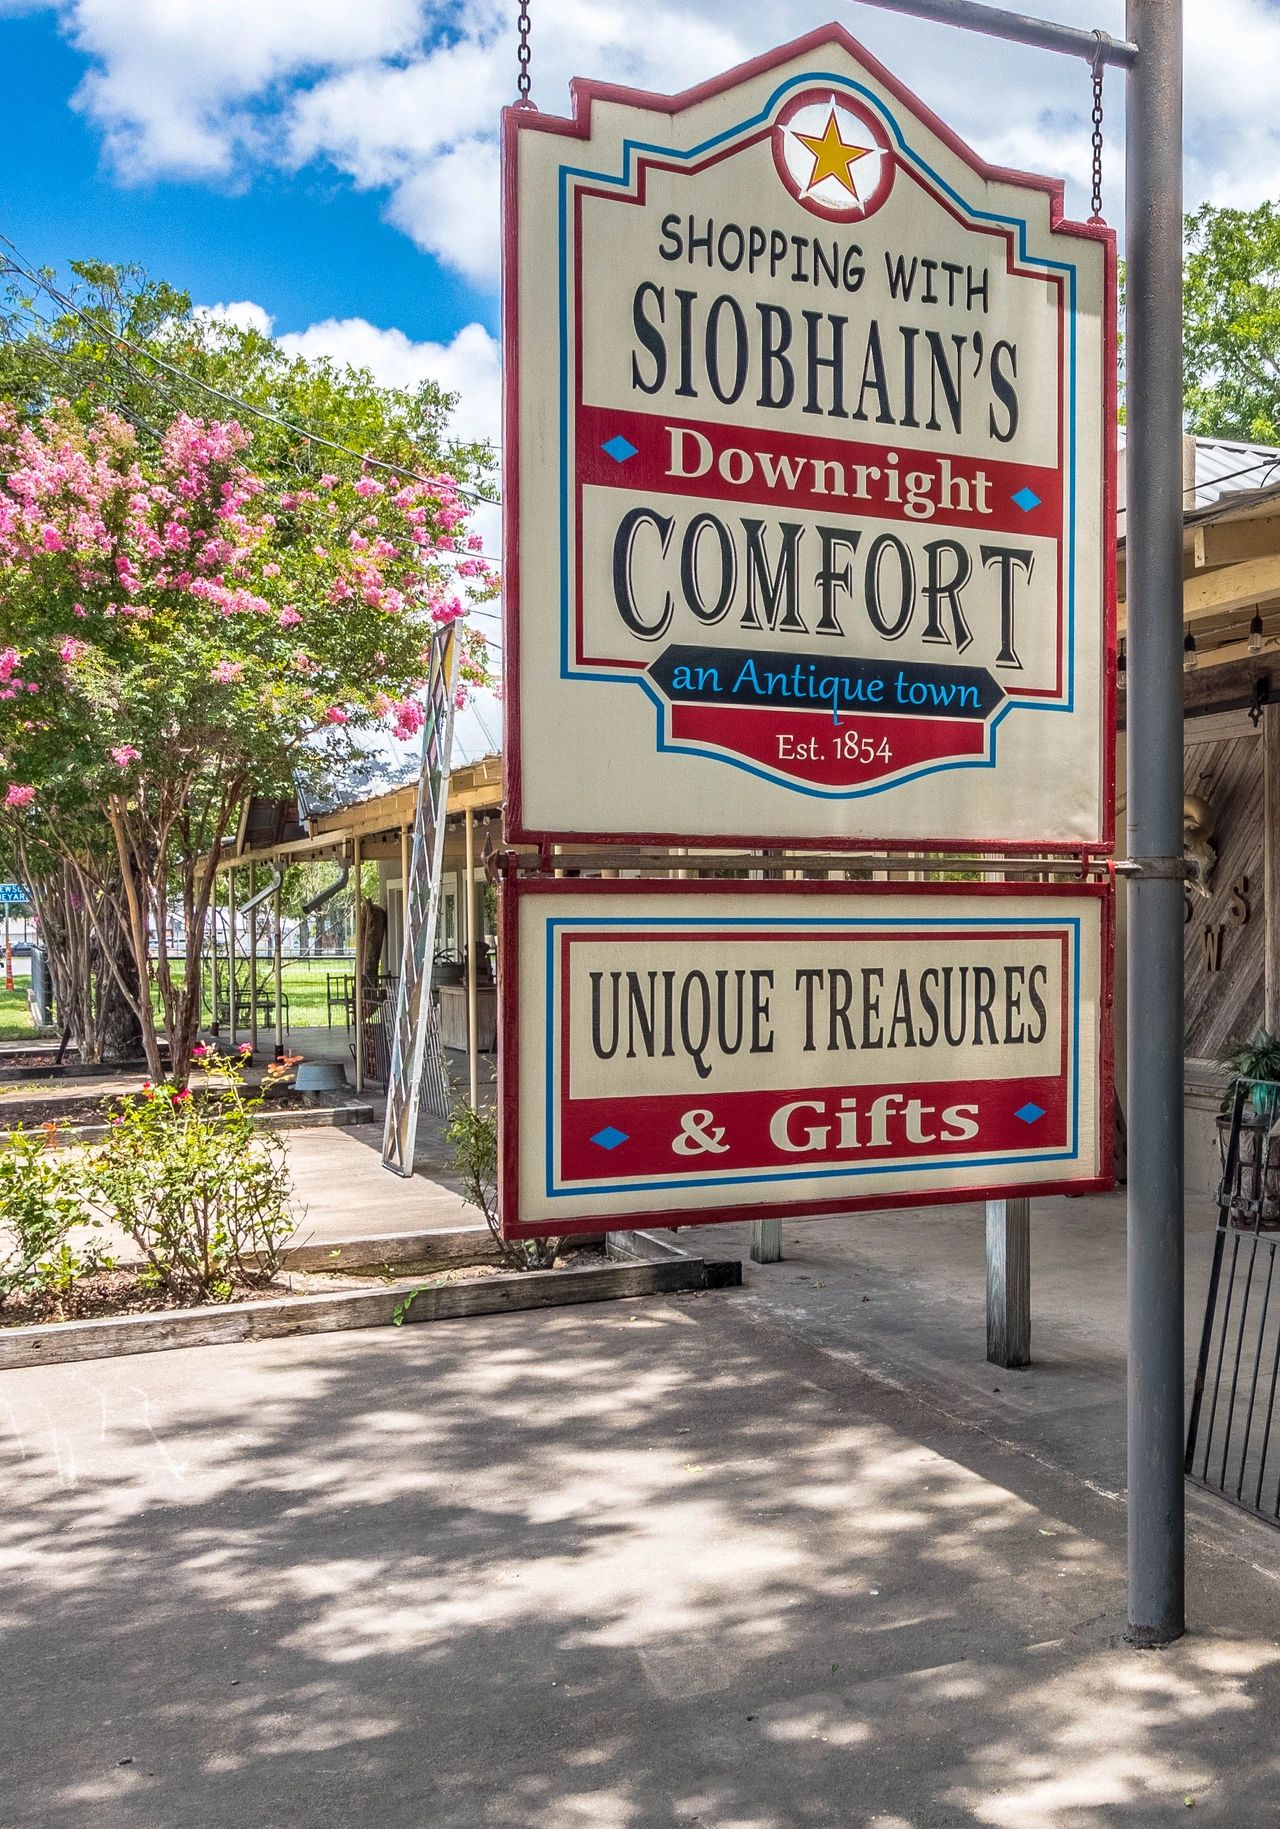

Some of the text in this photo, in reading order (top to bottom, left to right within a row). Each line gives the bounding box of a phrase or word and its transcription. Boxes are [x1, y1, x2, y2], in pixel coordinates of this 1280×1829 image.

[658, 213, 989, 314] SHOPPING WITH
[631, 280, 1019, 443] SIOBHAIN'S
[665, 426, 993, 519] Downright
[612, 506, 1035, 670] COMFORT
[672, 659, 982, 726] an Antique town
[775, 731, 893, 765] Est. 1854
[589, 964, 1048, 1079] UNIQUE TREASURES
[671, 1094, 980, 1155] & Gifts
